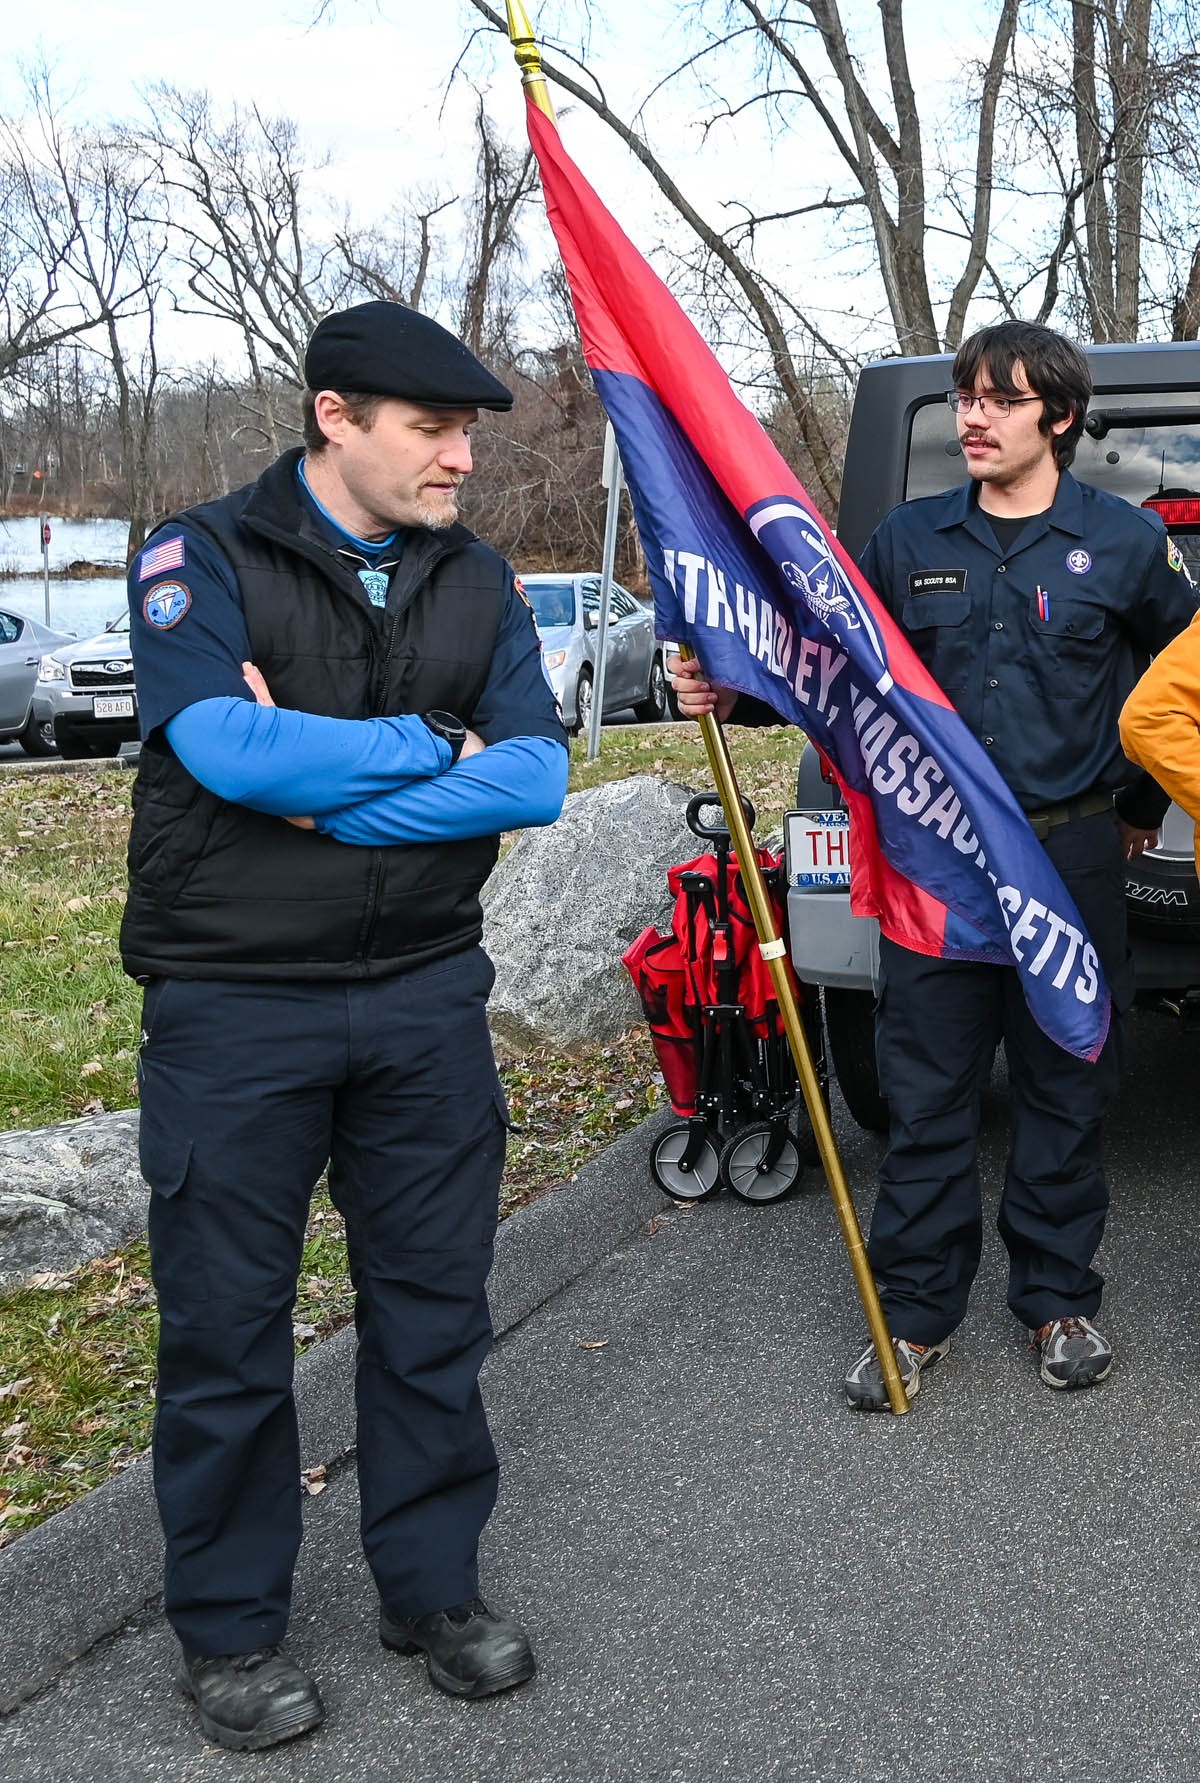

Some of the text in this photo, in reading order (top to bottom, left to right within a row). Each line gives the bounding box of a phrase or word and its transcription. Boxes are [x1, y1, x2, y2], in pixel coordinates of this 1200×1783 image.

[914, 576, 957, 587] SEA SCOUTS BSA
[96, 702, 113, 713] 528
[805, 831, 850, 866] TH
[811, 873, 851, 885] U.S. AI
